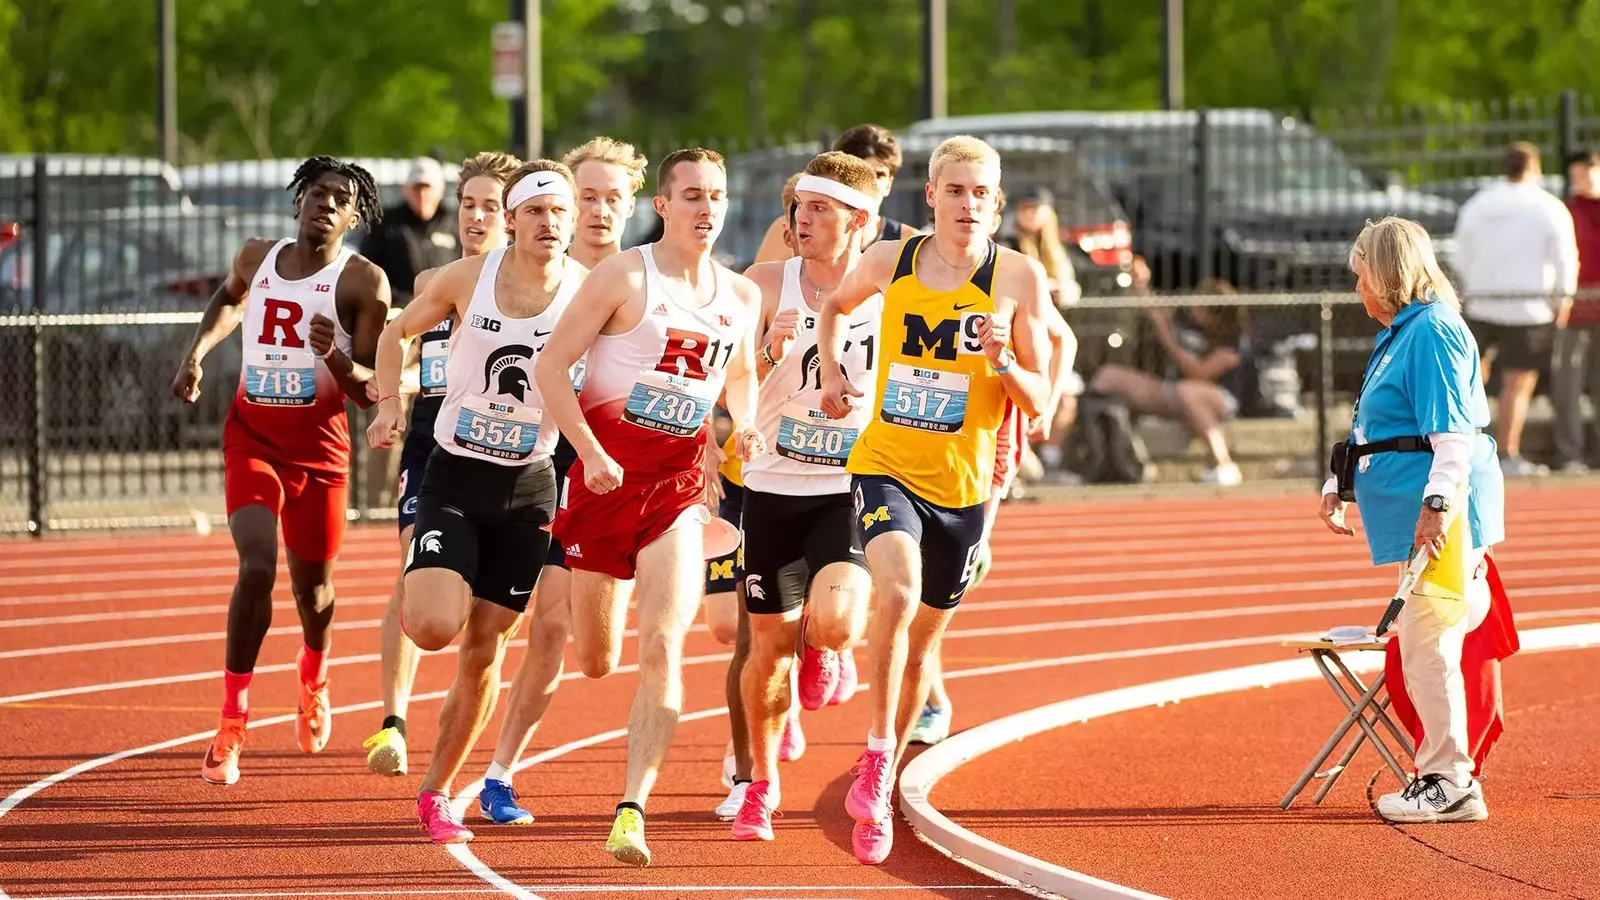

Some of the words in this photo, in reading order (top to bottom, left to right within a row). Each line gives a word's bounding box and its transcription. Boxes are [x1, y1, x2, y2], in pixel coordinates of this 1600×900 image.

[258, 298, 305, 348] R
[901, 313, 961, 361] M
[654, 327, 709, 381] R
[256, 370, 302, 395] 718
[643, 388, 697, 424] 730
[895, 386, 952, 419] 517
[469, 415, 523, 448] 554
[790, 423, 843, 455] 540
[862, 505, 892, 531] M
[710, 559, 735, 580] M
